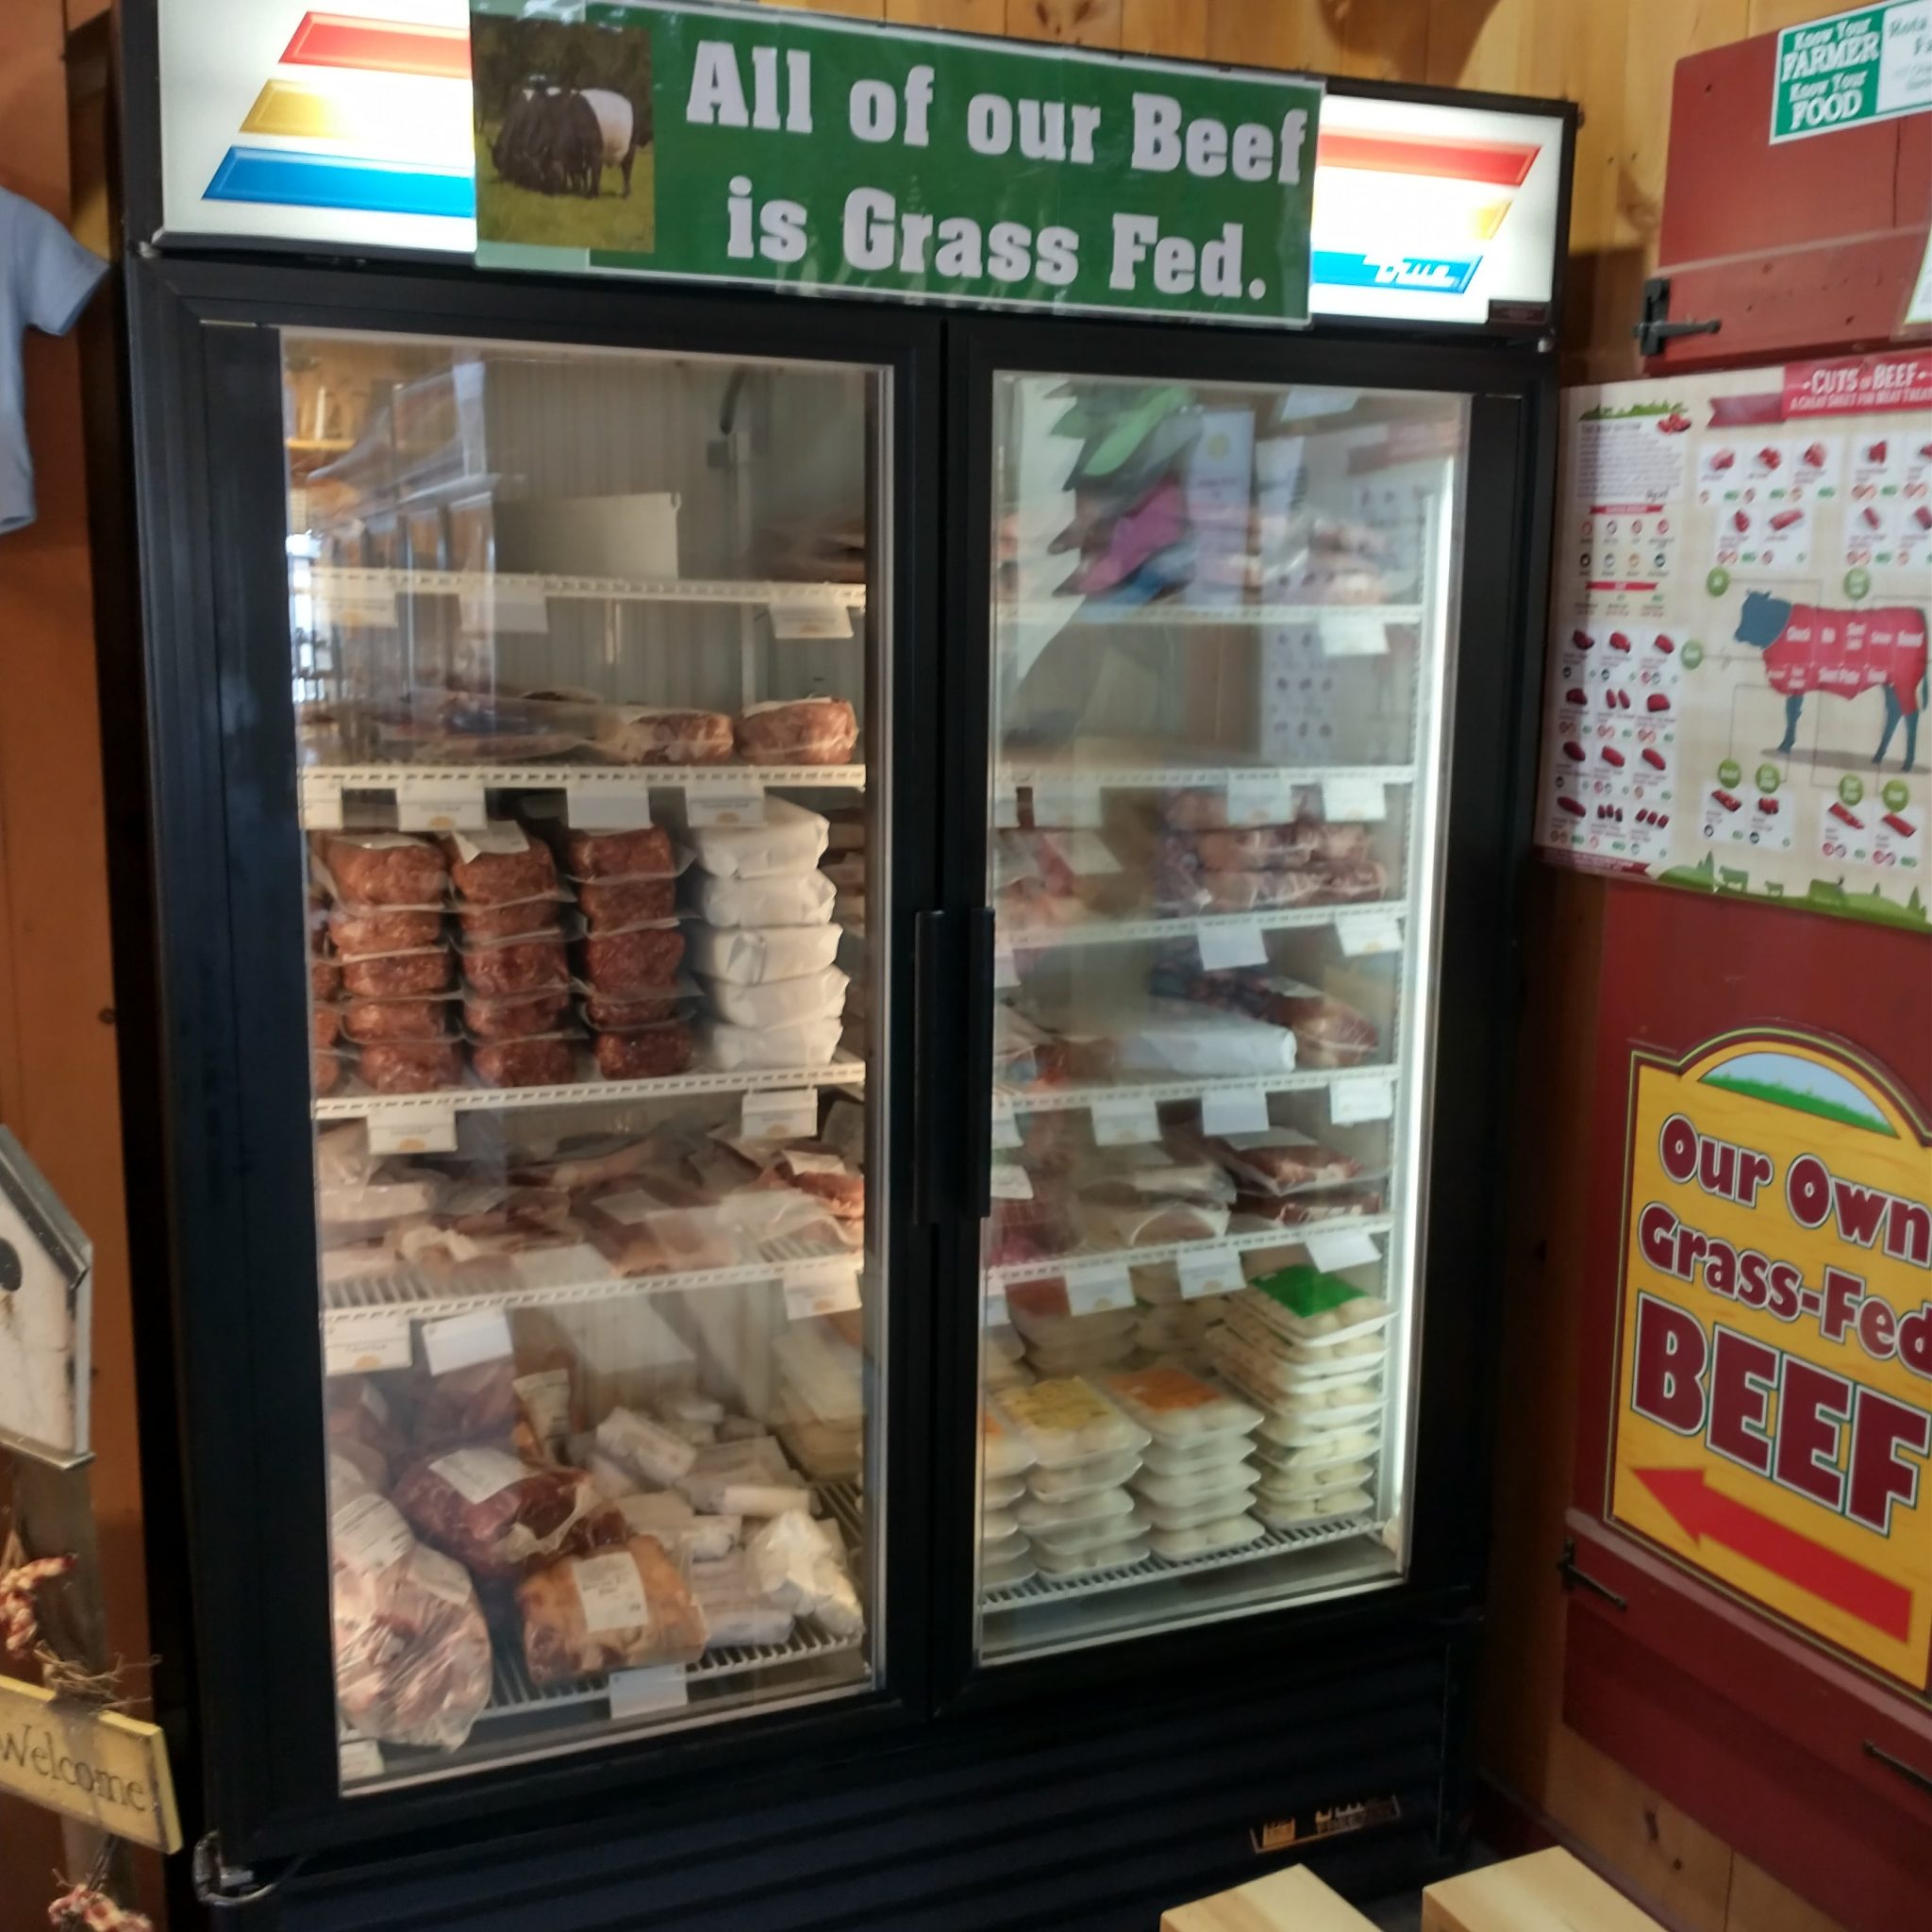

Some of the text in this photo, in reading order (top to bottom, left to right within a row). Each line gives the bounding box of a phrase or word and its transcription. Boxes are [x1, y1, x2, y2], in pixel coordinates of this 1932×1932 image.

[687, 41, 1307, 185] All of our Beef
[1781, 31, 1881, 82] FARMER
[1790, 90, 1862, 130] FOOD
[727, 175, 1266, 300] is Grass Fed.
[1811, 368, 1859, 394] CUTS
[1873, 361, 1919, 391] BEEF
[1659, 1113, 1932, 1269] Our Own
[1639, 1202, 1932, 1382] Grass-Fed
[1632, 1290, 1931, 1538] BEEF
[1, 1724, 146, 1812] Welcome
